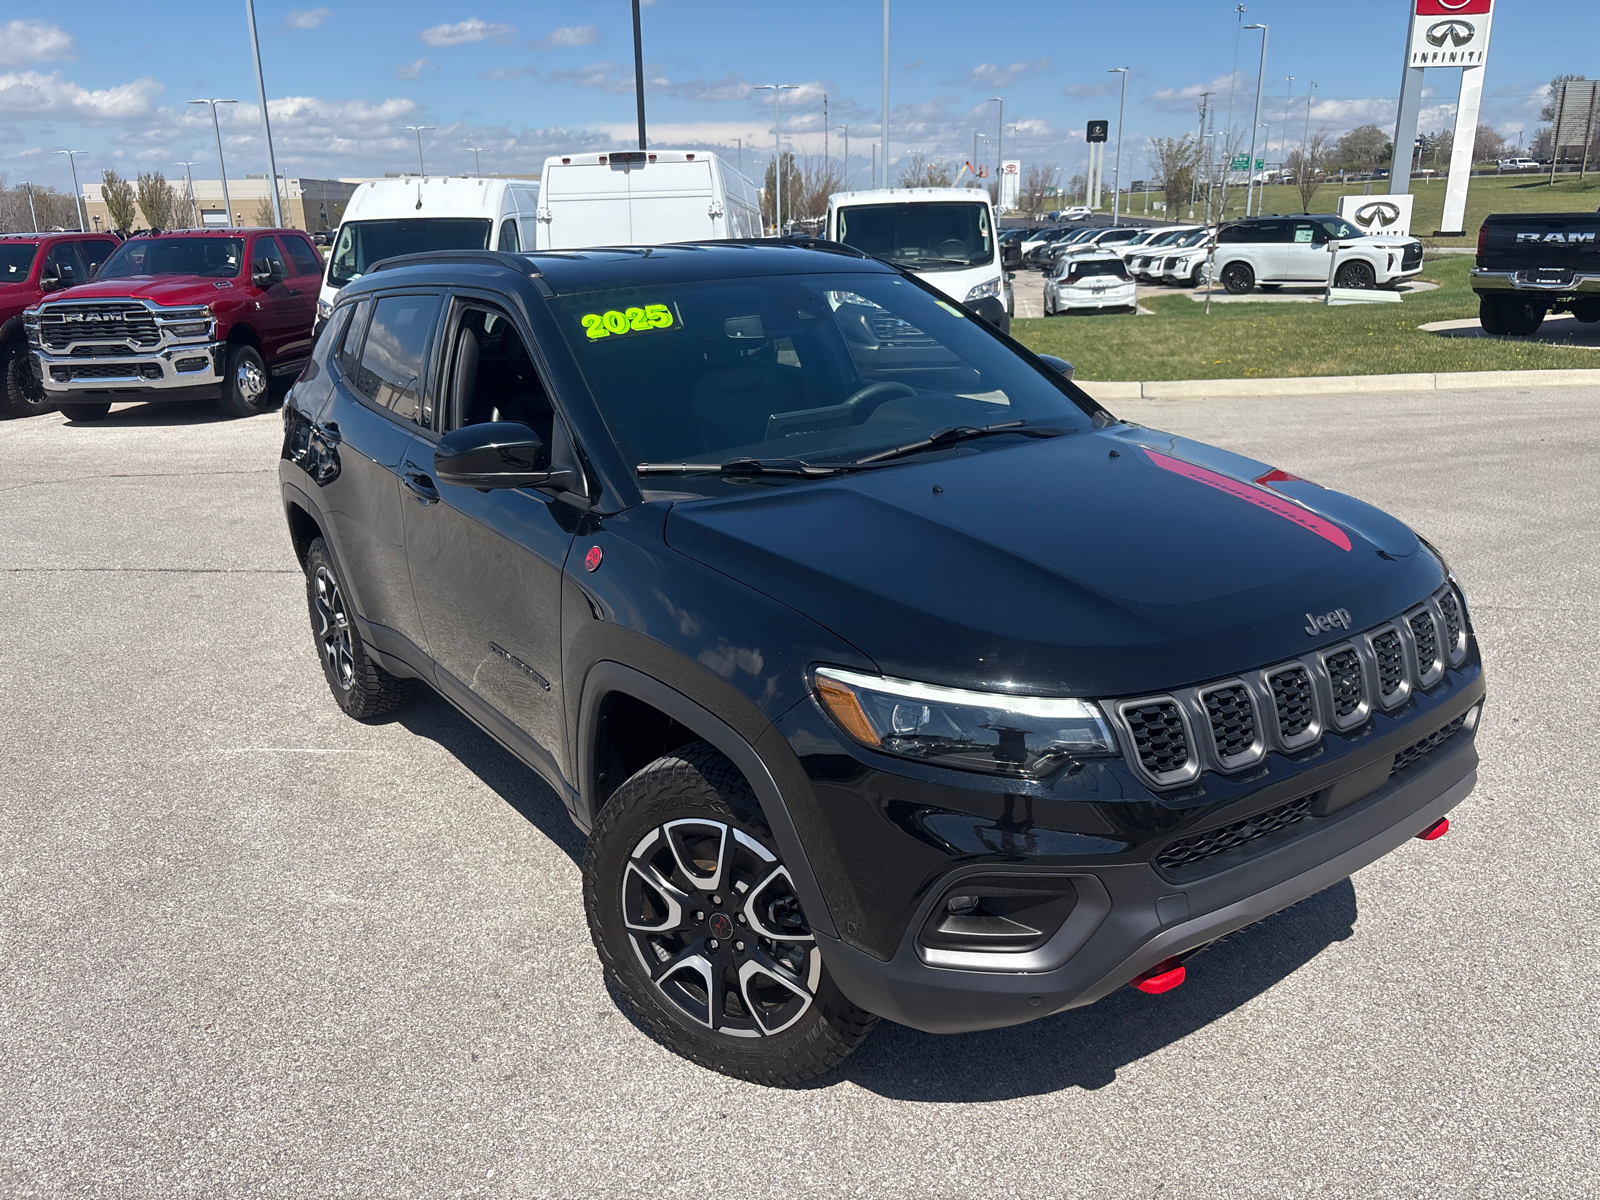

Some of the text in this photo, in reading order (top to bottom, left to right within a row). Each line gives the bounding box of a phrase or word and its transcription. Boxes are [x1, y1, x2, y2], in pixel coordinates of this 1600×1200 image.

[1413, 51, 1483, 63] INFINITI
[1516, 232, 1596, 243] RAM
[65, 312, 122, 323] RAM
[581, 304, 673, 339] 2025
[1303, 607, 1352, 637] Jeep
